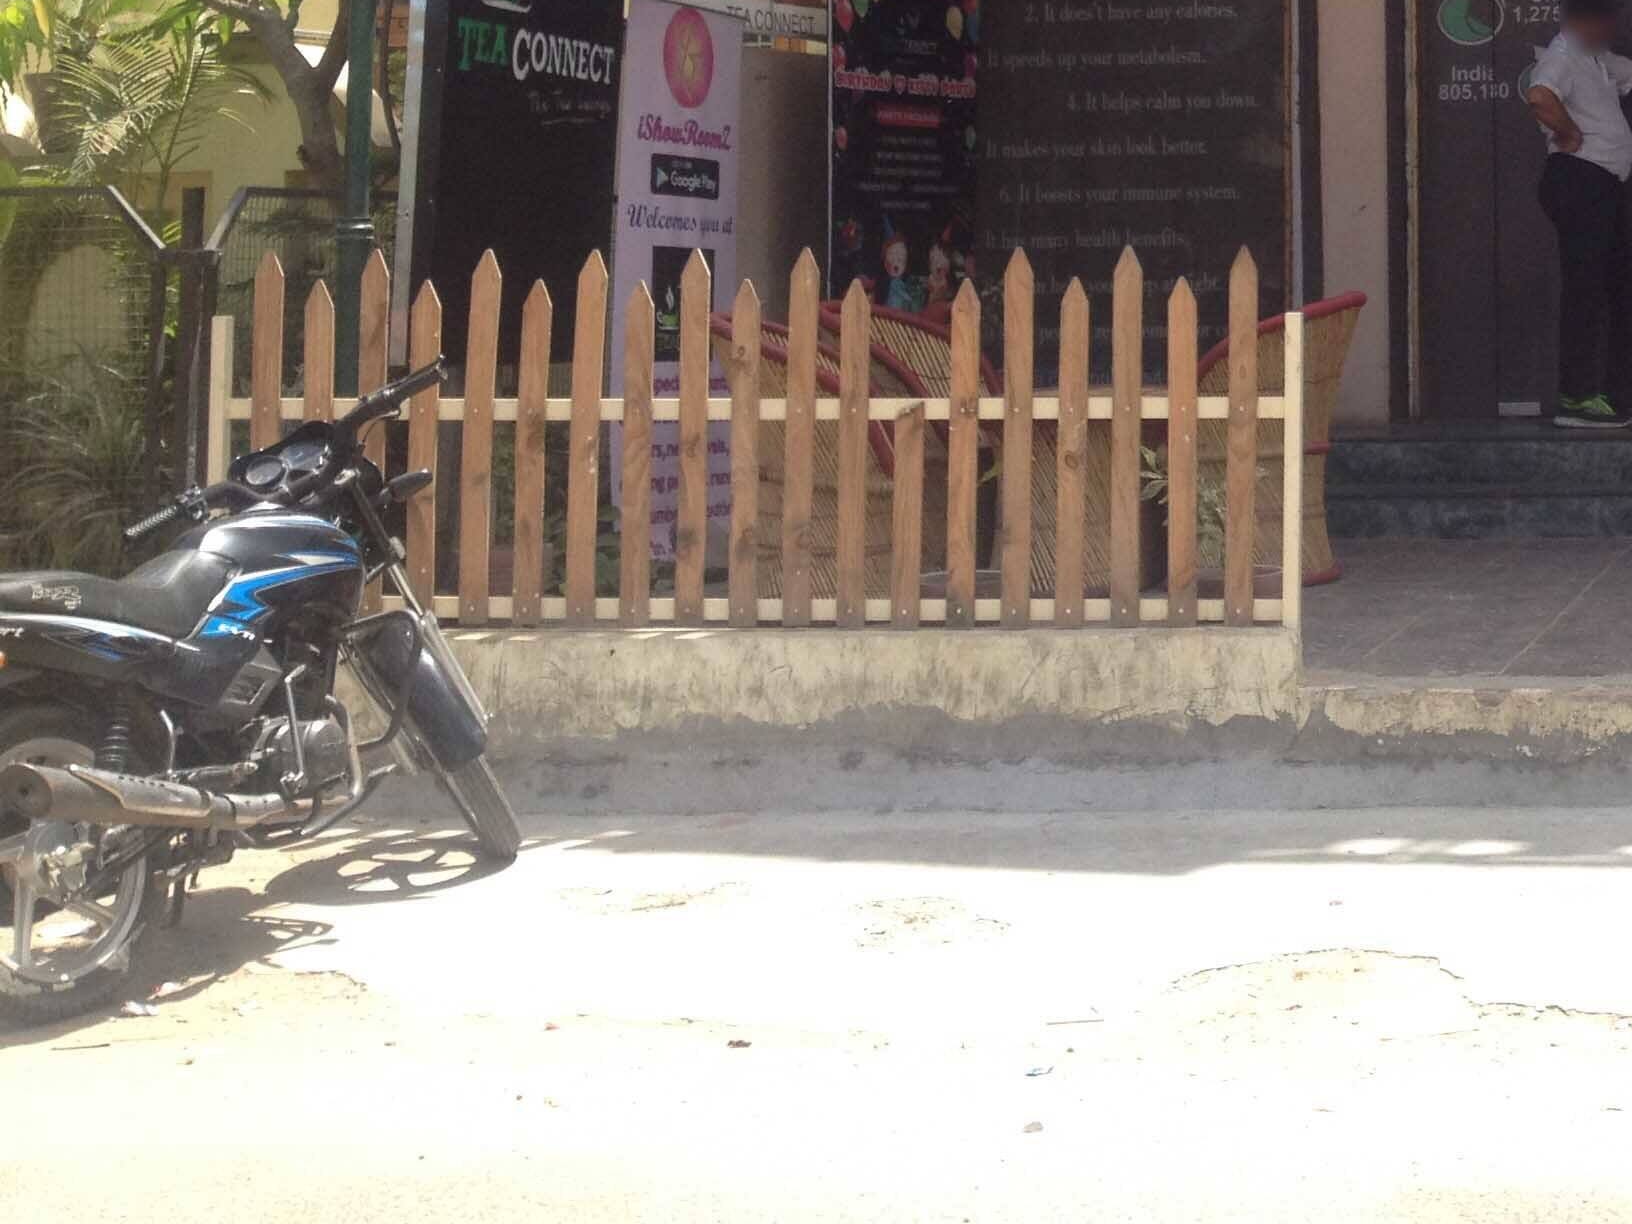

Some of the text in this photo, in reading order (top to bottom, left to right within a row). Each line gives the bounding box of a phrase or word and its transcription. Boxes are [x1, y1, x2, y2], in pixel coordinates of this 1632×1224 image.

[754, 9, 815, 35] CONNECT
[457, 17, 615, 86] TEA CONNECT
[627, 202, 697, 232] Welcomes
[700, 216, 720, 237] you
